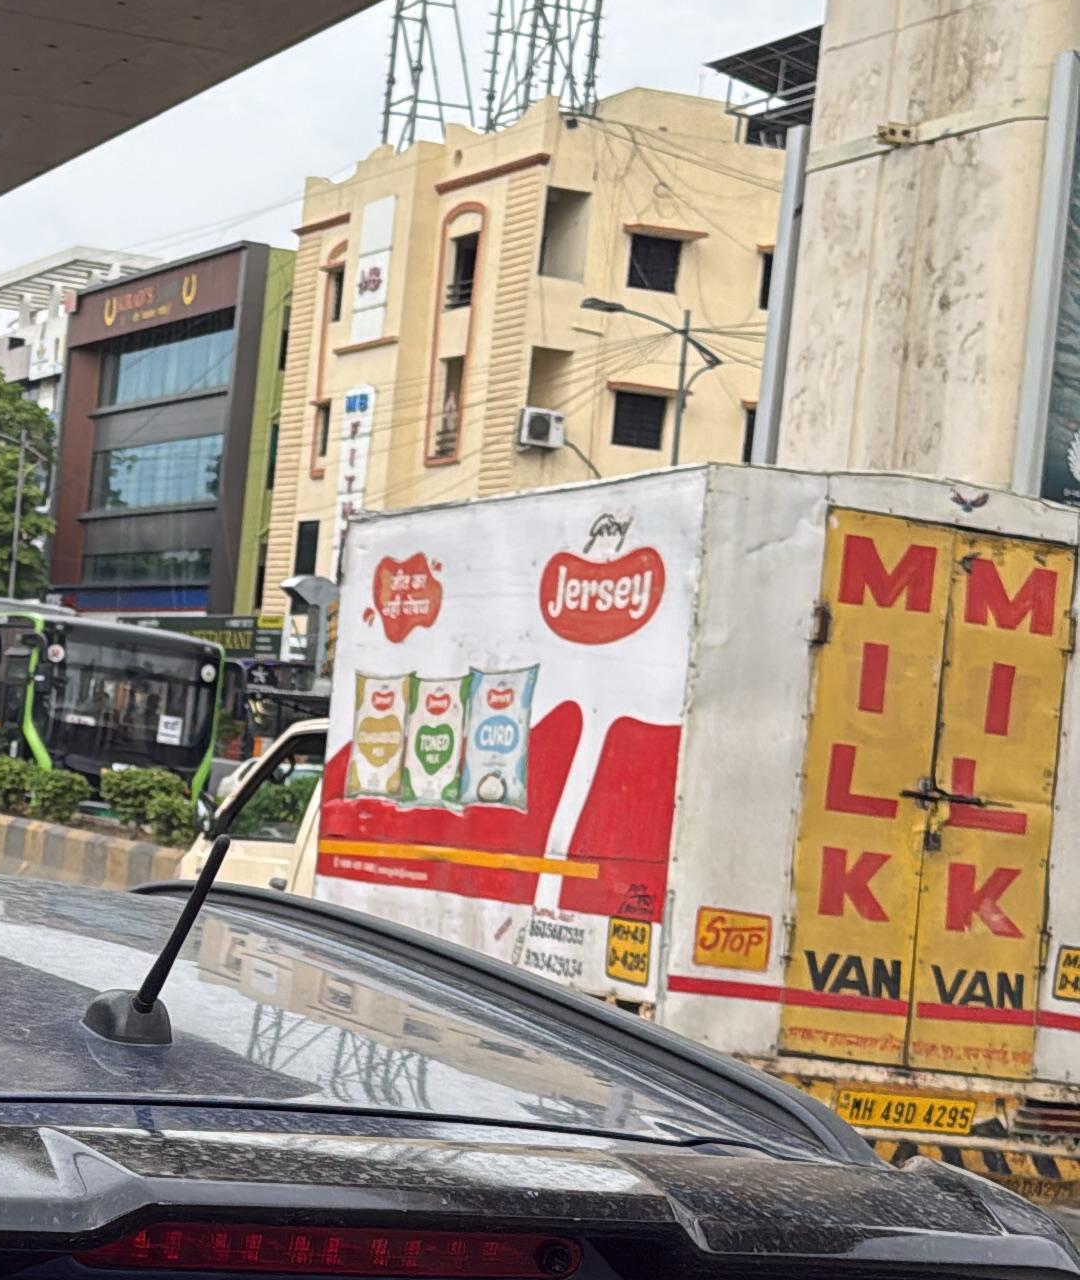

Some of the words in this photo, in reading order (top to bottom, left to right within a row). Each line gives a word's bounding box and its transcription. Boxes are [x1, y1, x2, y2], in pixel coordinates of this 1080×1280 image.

[547, 565, 653, 620] Jersey
[420, 734, 450, 752] TONED
[479, 724, 514, 747] CURD
[818, 534, 937, 922] MILK
[944, 557, 1058, 940] MILK
[699, 916, 766, 957] STOP
[609, 947, 648, 972] D-4295
[804, 950, 902, 1000] VAN
[931, 965, 1024, 1010] VAN
[849, 1096, 876, 1120] MH
[922, 1105, 972, 1130] 4295
